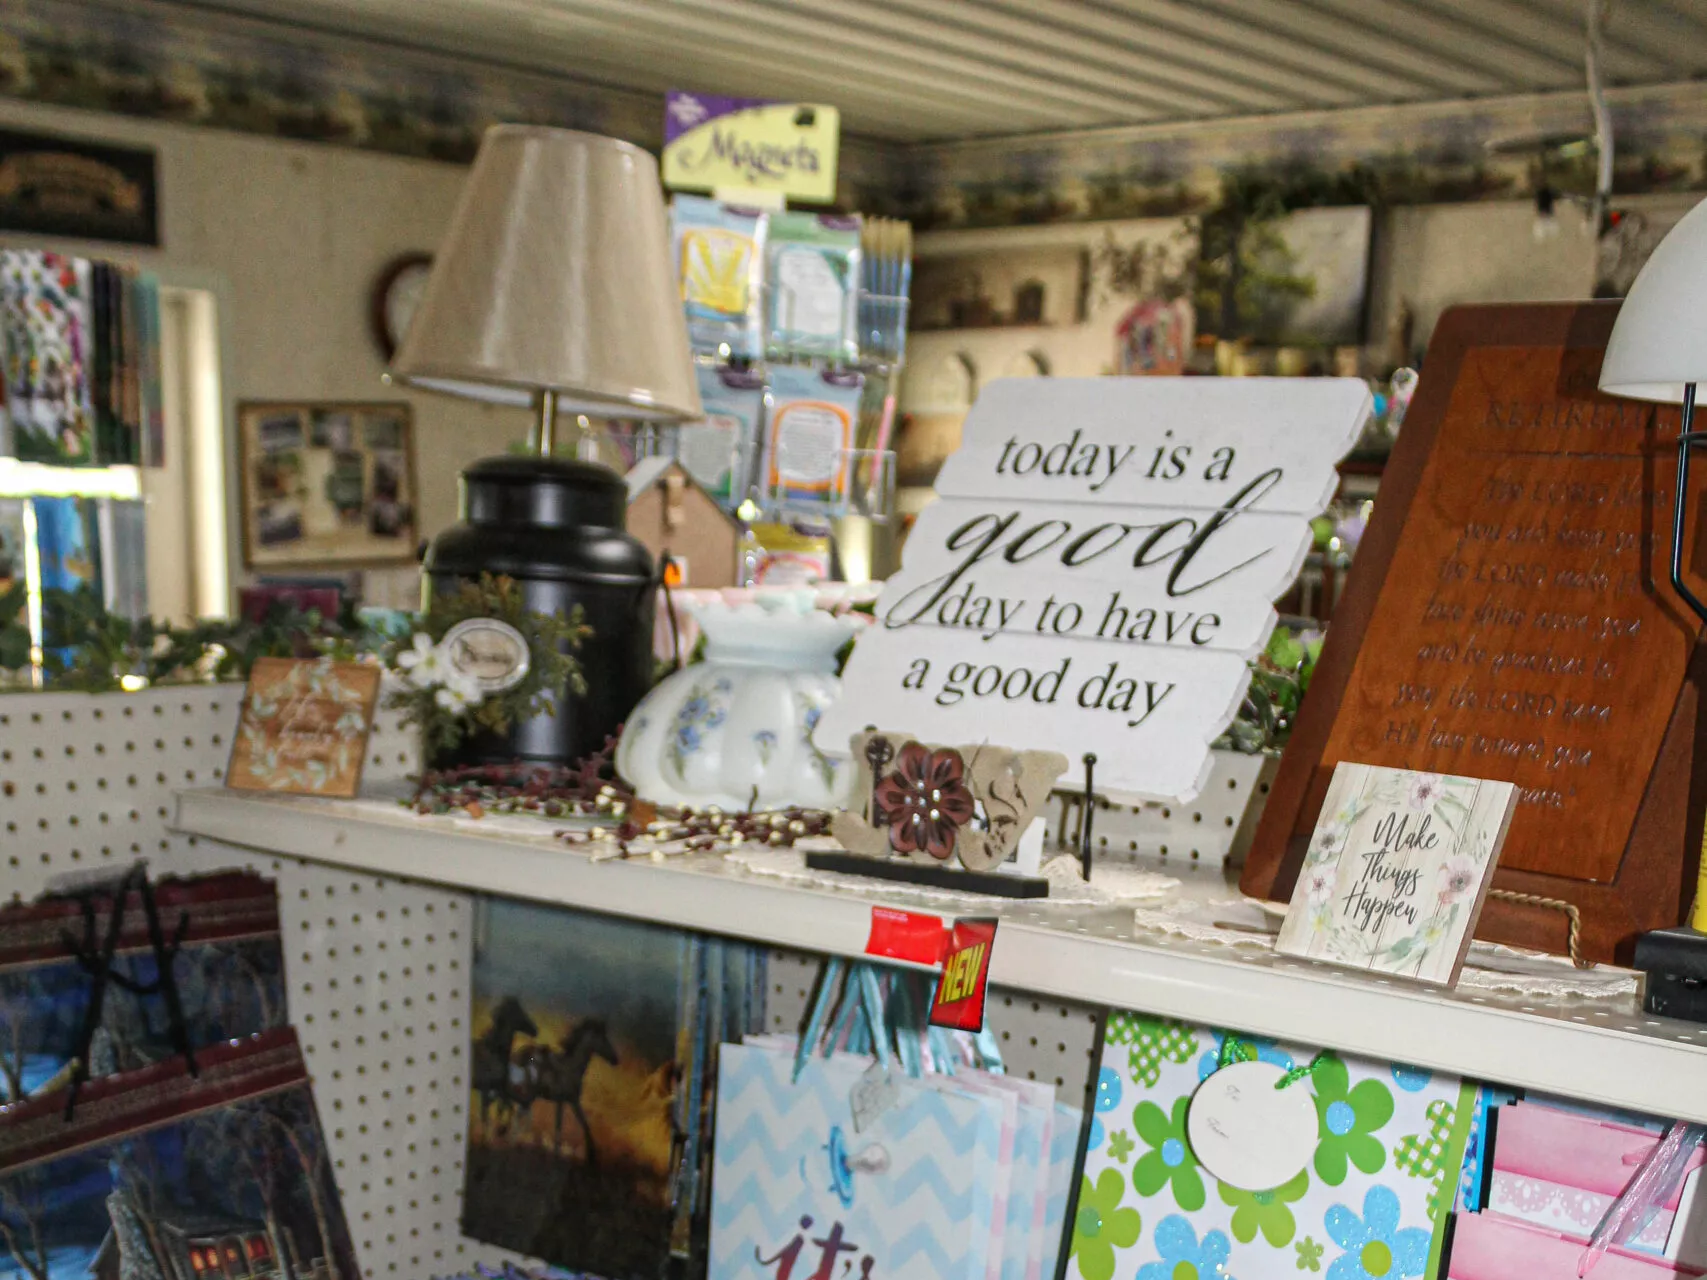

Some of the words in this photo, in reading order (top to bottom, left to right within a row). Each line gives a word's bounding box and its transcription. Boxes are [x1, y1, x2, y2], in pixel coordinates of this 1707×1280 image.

[676, 123, 820, 185] Magnets
[996, 429, 1134, 491] today
[1144, 430, 1192, 481] is
[1204, 446, 1235, 481] a
[884, 467, 1283, 630] good
[937, 582, 1025, 641] day
[1036, 595, 1083, 633] to
[1097, 591, 1221, 645] have
[902, 657, 930, 689] a
[936, 657, 1072, 706] good
[1077, 661, 1175, 728] day
[1483, 691, 1556, 718] LORD
[1372, 811, 1439, 852] Make
[1361, 847, 1424, 899] Things
[1342, 881, 1418, 934] Happen
[938, 942, 986, 1005] NEW
